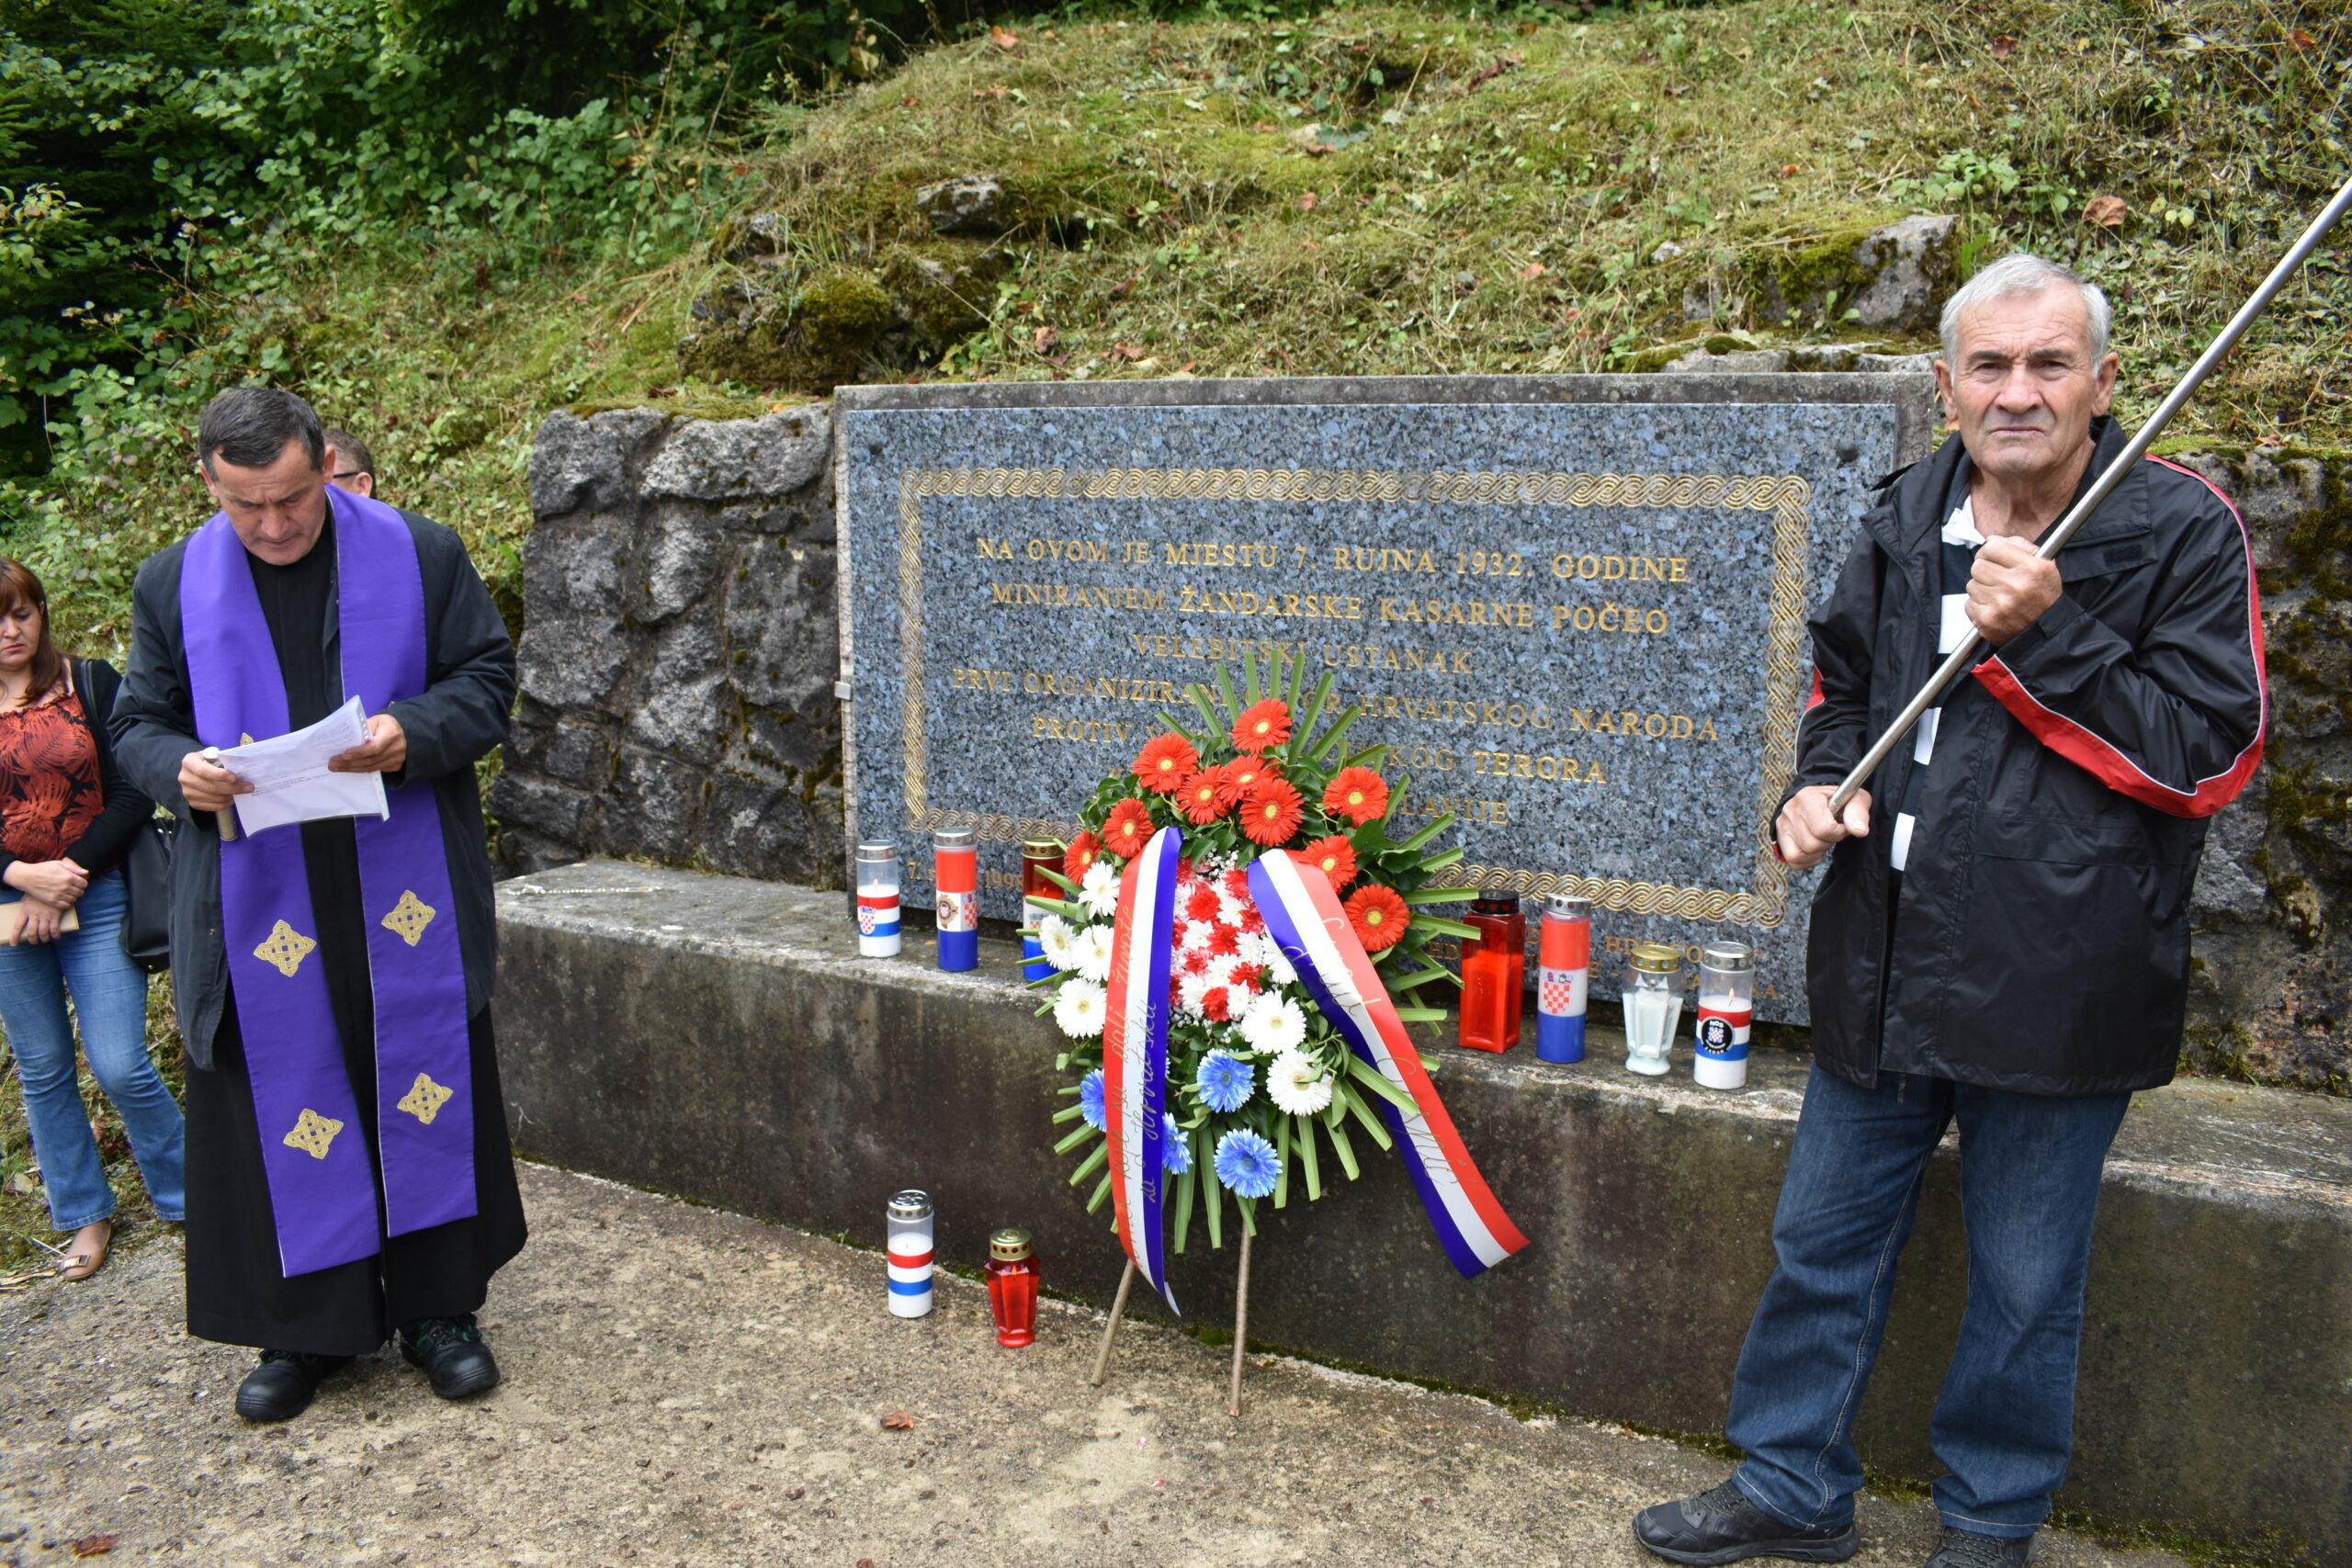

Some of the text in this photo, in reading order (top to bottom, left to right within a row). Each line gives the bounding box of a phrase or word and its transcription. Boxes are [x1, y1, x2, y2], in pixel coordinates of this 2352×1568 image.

[977, 537, 1689, 582] NA OVOM JE MJESTU 7. RUJNA 1932. GODINE
[991, 582, 1669, 634] MINIRANJEM ŽANDARSKE KASARNE POČEO
[1133, 634, 1473, 674] VELEBITSKI USTANAK
[953, 668, 1011, 692] PRVI
[1023, 671, 1228, 706] ORGANIZIRANI
[1360, 694, 1552, 729] HRVATSKOG
[1569, 706, 1719, 741] NARODA
[1033, 716, 1132, 742] PROTIV
[1472, 750, 1607, 784] TERORA
